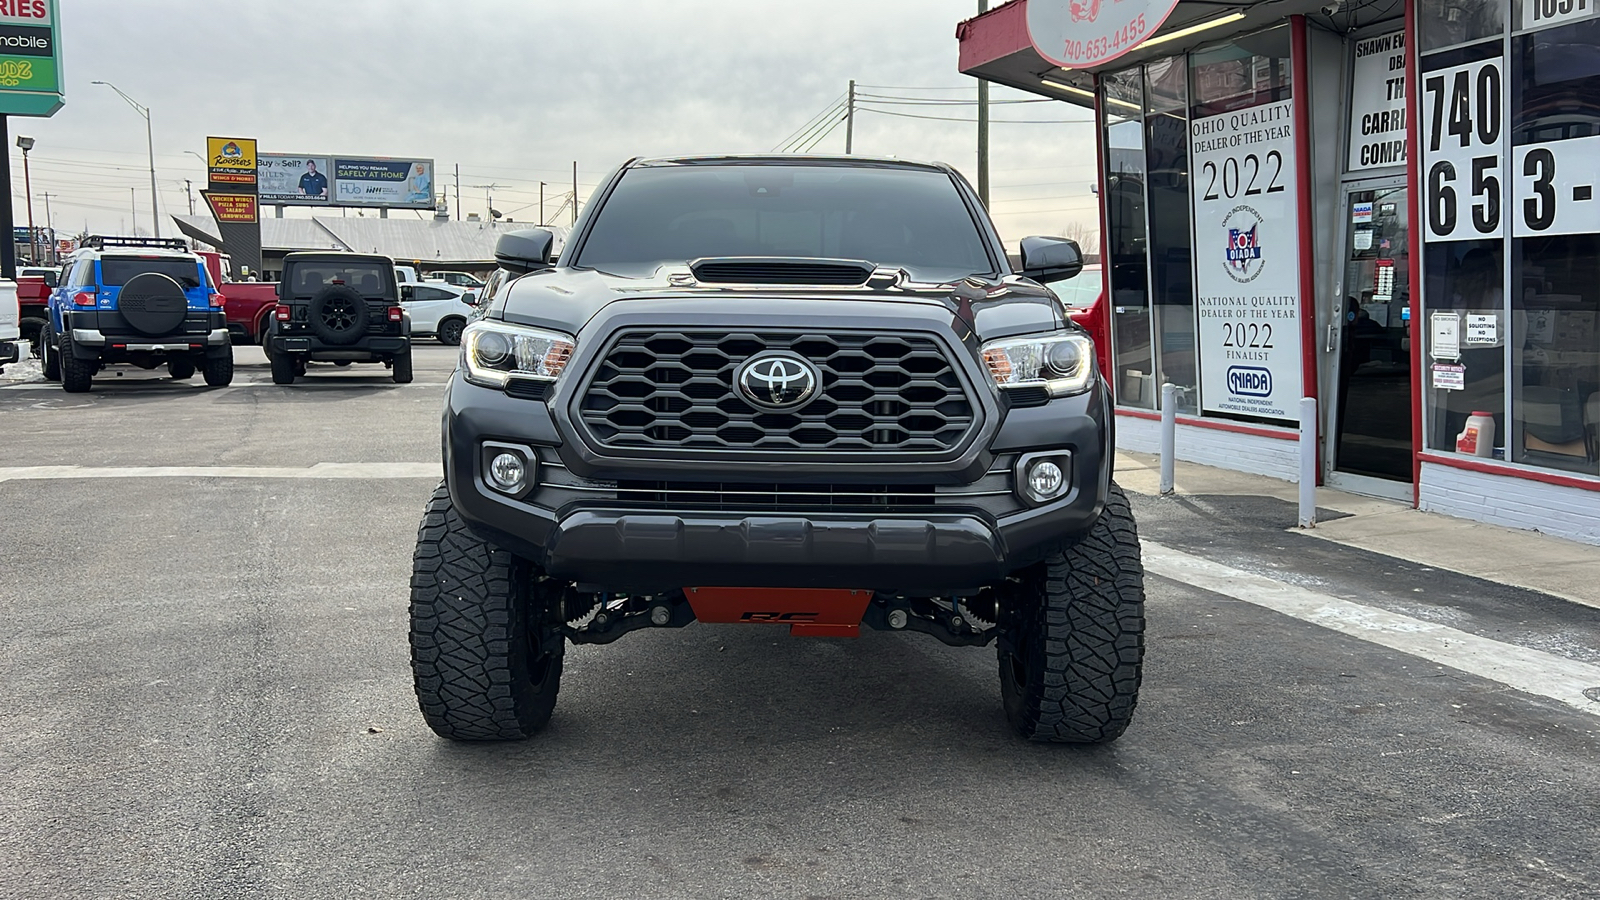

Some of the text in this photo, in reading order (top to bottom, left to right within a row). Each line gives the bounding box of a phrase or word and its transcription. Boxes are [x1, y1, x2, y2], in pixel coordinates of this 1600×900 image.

[1063, 12, 1146, 60] 740-653-4455
[1357, 33, 1406, 58] SHAWN EV
[1386, 78, 1406, 101] TH
[1426, 64, 1500, 152] 740
[1193, 118, 1225, 137] OHIO
[1231, 104, 1292, 131] QUALITY
[1361, 110, 1406, 136] CARRI
[1194, 125, 1291, 153] DEALER OF THE YEAR
[213, 155, 252, 166] Roosters
[1202, 150, 1285, 201] 2022
[1222, 205, 1264, 227] OHIO INDEPENDENT
[1230, 247, 1255, 259] OIADA
[1200, 296, 1296, 306] NATIONAL QUALITY
[1201, 309, 1296, 318] DEALER OF THE YEAR
[1222, 322, 1274, 348] 2022
[1226, 351, 1269, 361] FINALIST
[1230, 372, 1268, 391] NIADA
[1258, 407, 1285, 415] ASSOCIATION
